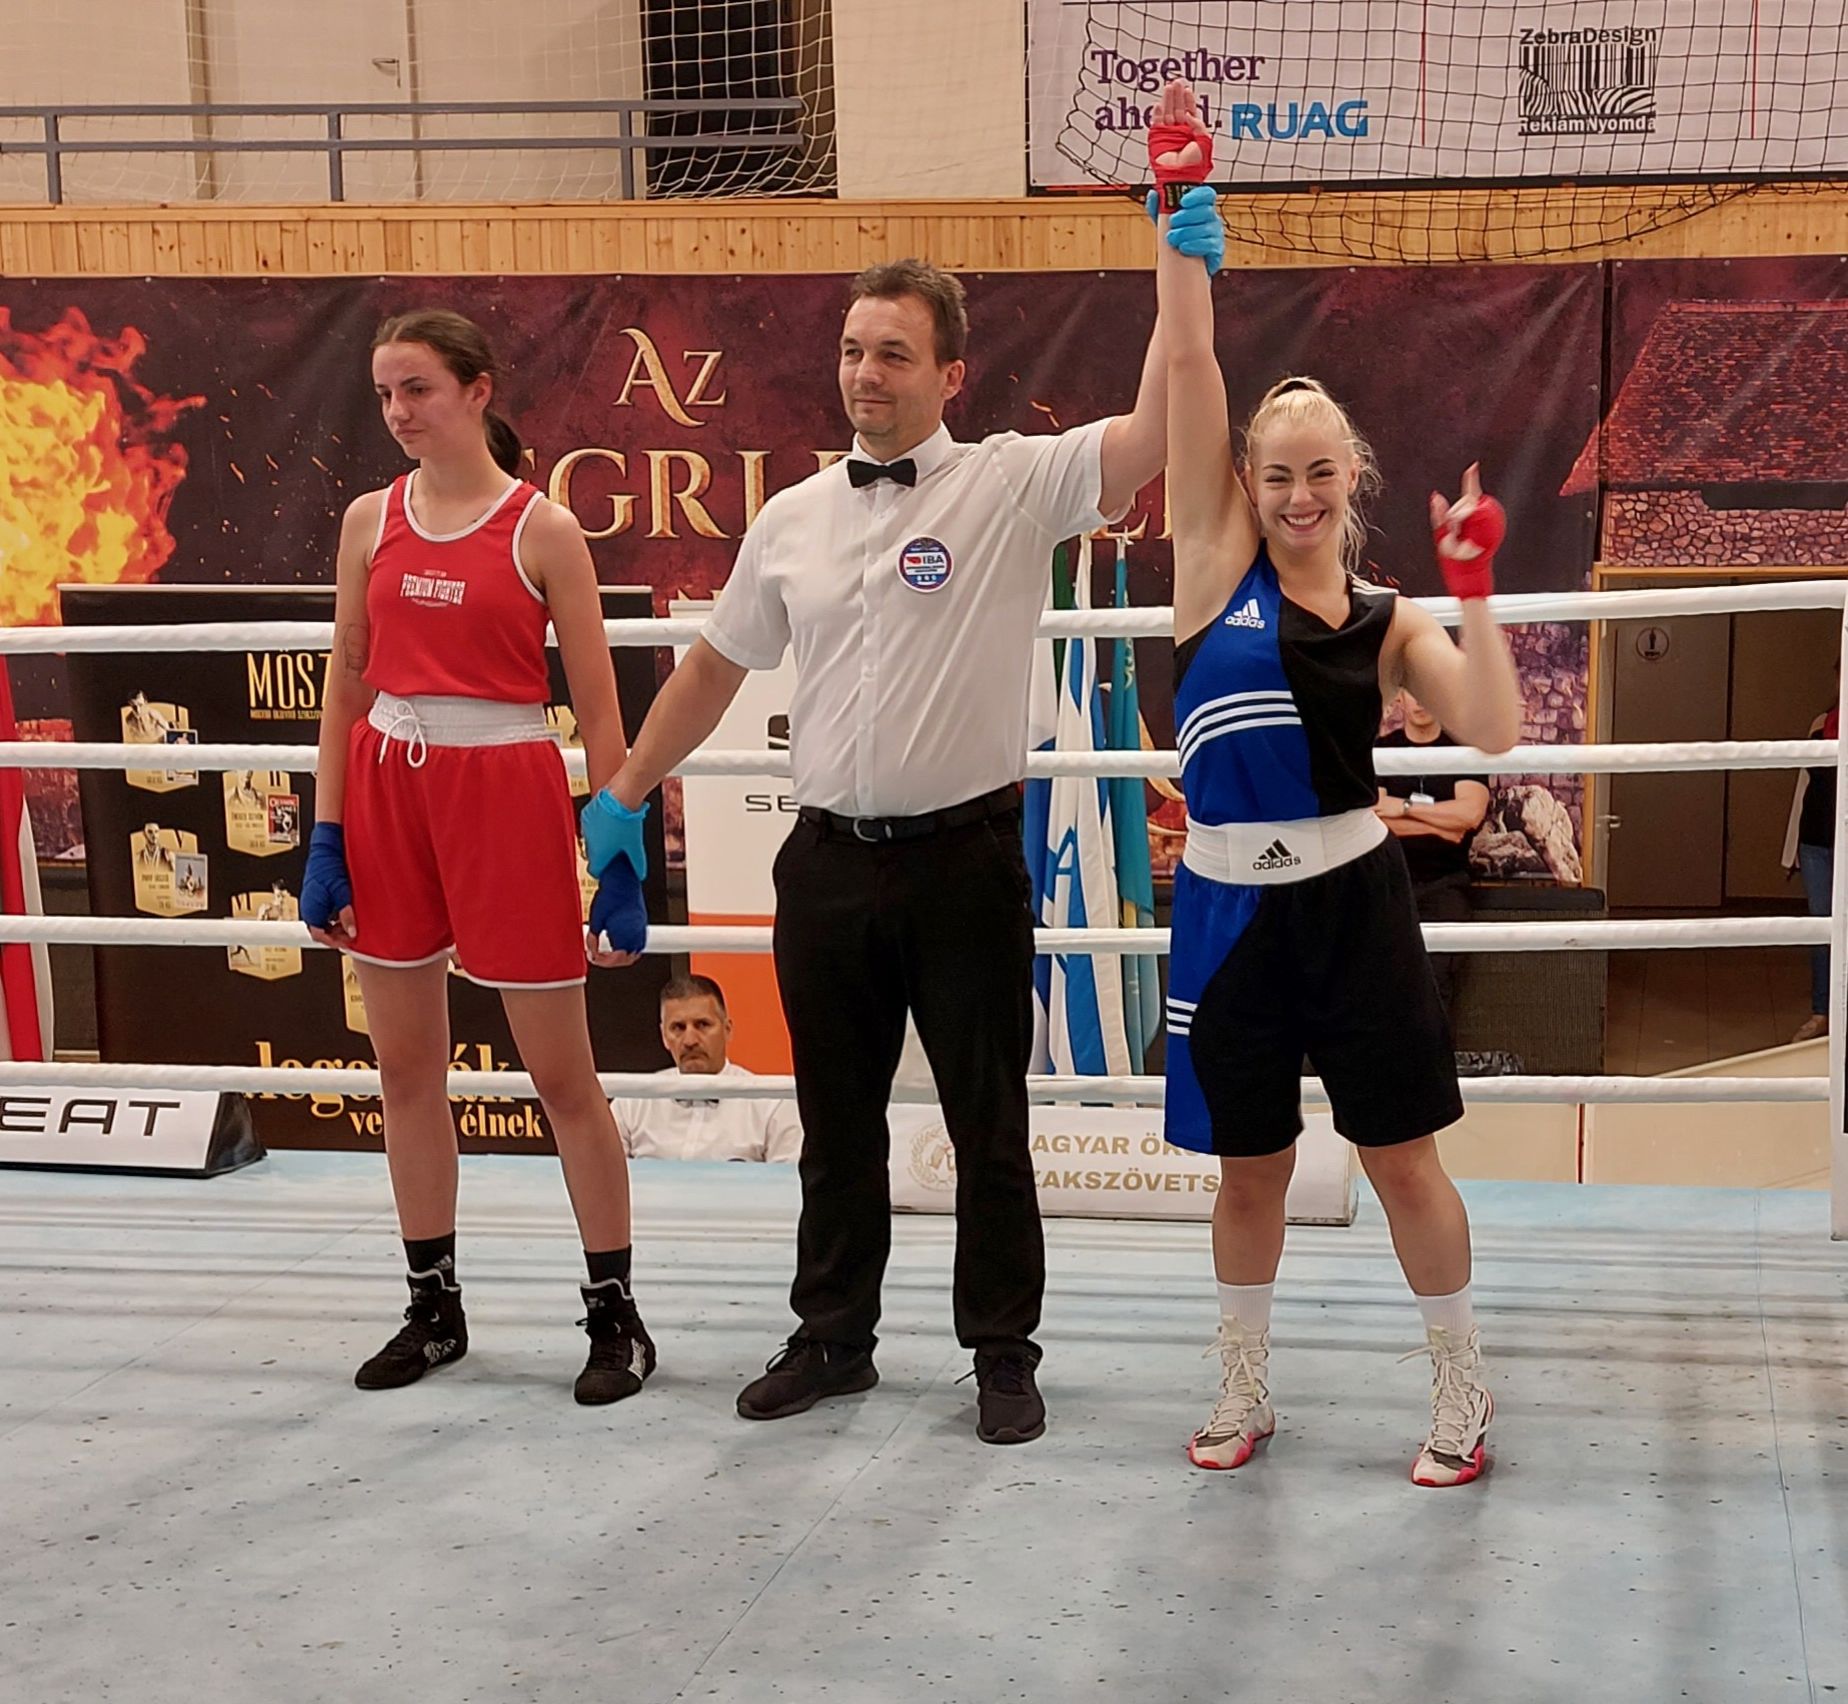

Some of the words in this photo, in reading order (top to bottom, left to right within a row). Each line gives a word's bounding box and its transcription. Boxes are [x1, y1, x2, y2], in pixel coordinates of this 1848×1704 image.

[1519, 26, 1657, 46] ZebraDesign
[1091, 48, 1265, 92] Together
[1094, 95, 1222, 131] ahd.
[1231, 100, 1369, 140] RUAG
[612, 327, 727, 428] Az
[524, 448, 773, 539] GRI
[922, 555, 945, 565] IBA
[745, 795, 801, 812] SE
[1252, 854, 1302, 871] adidas
[0, 1097, 181, 1137] EAT
[460, 1105, 544, 1138] élnek
[1032, 1135, 1130, 1155] AGYAR
[1036, 1167, 1219, 1193] AKSZÖVETS
